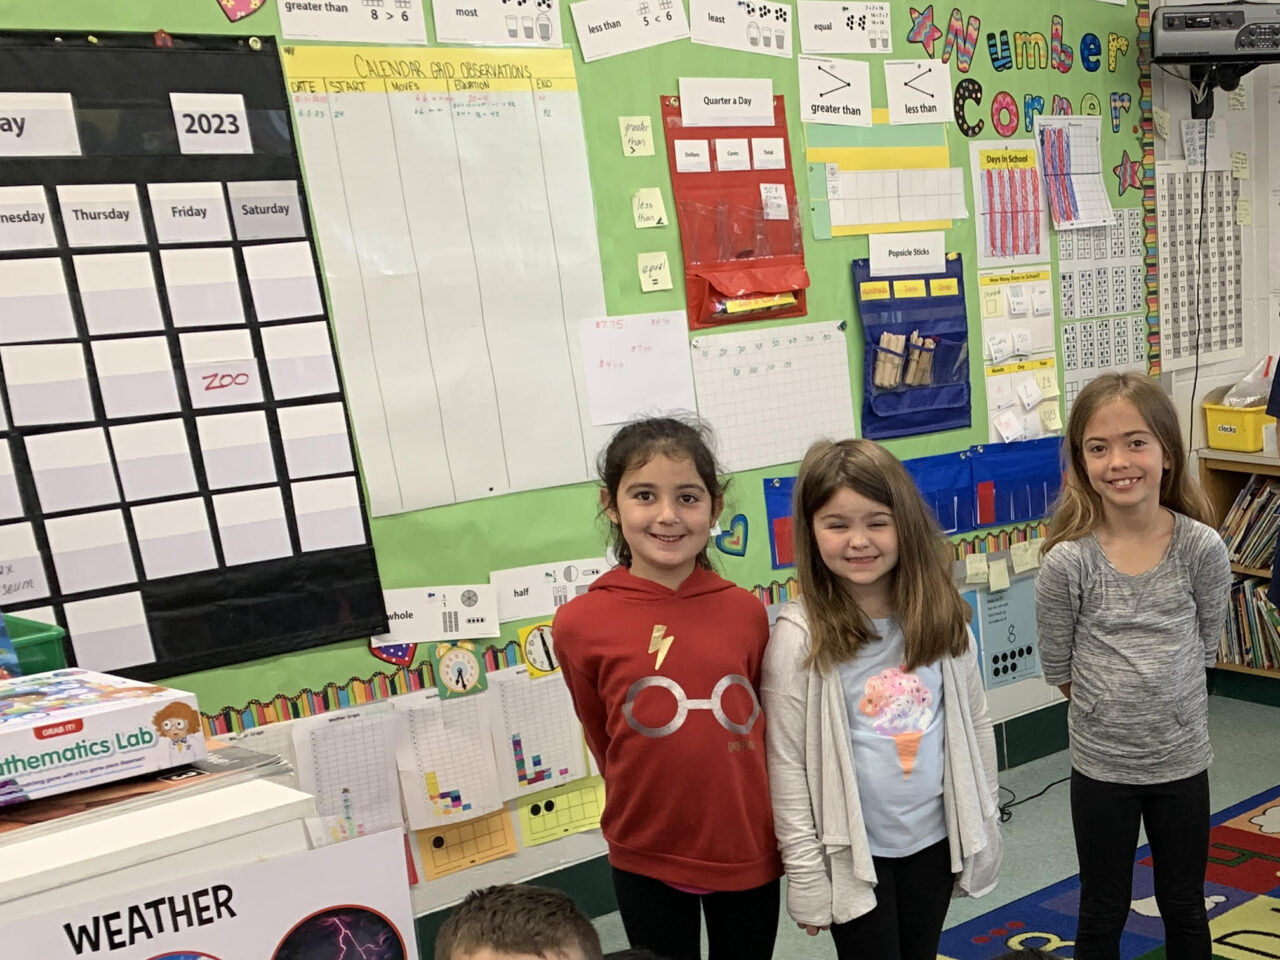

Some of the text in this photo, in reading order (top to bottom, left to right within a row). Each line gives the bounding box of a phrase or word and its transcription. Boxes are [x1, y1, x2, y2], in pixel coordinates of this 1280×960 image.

[285, 0, 348, 12] greater than
[370, 10, 409, 22] 8 6
[455, 8, 478, 17] most
[707, 13, 725, 24] least
[643, 11, 673, 27] 5 6
[588, 19, 621, 34] less than
[813, 22, 833, 32] equal
[942, 8, 1129, 73] Number
[354, 54, 532, 78] CALENDAR GRID OBSERVATIONS
[291, 81, 316, 93] DATE
[329, 81, 366, 93] START
[703, 96, 731, 107] Quarter
[738, 97, 752, 107] Day
[811, 103, 861, 117] greater than
[905, 103, 937, 114] less than
[182, 113, 240, 135] 2023
[624, 120, 650, 137] greater
[628, 136, 645, 146] than
[986, 155, 1001, 165] Days
[1009, 154, 1028, 164] School
[637, 197, 653, 210] less
[72, 208, 130, 221] Thursday
[171, 205, 207, 219] Friday
[241, 203, 290, 217] Saturday
[638, 213, 655, 222] than
[888, 247, 930, 258] Popsicle Sticks
[202, 372, 249, 391] ZOO
[1218, 424, 1236, 433] clocks
[514, 587, 529, 597] half
[387, 610, 414, 621] whole
[1007, 624, 1017, 643] 8
[42, 727, 65, 736] GRAB
[115, 727, 153, 750] Lab
[63, 883, 237, 956] WEATHER
